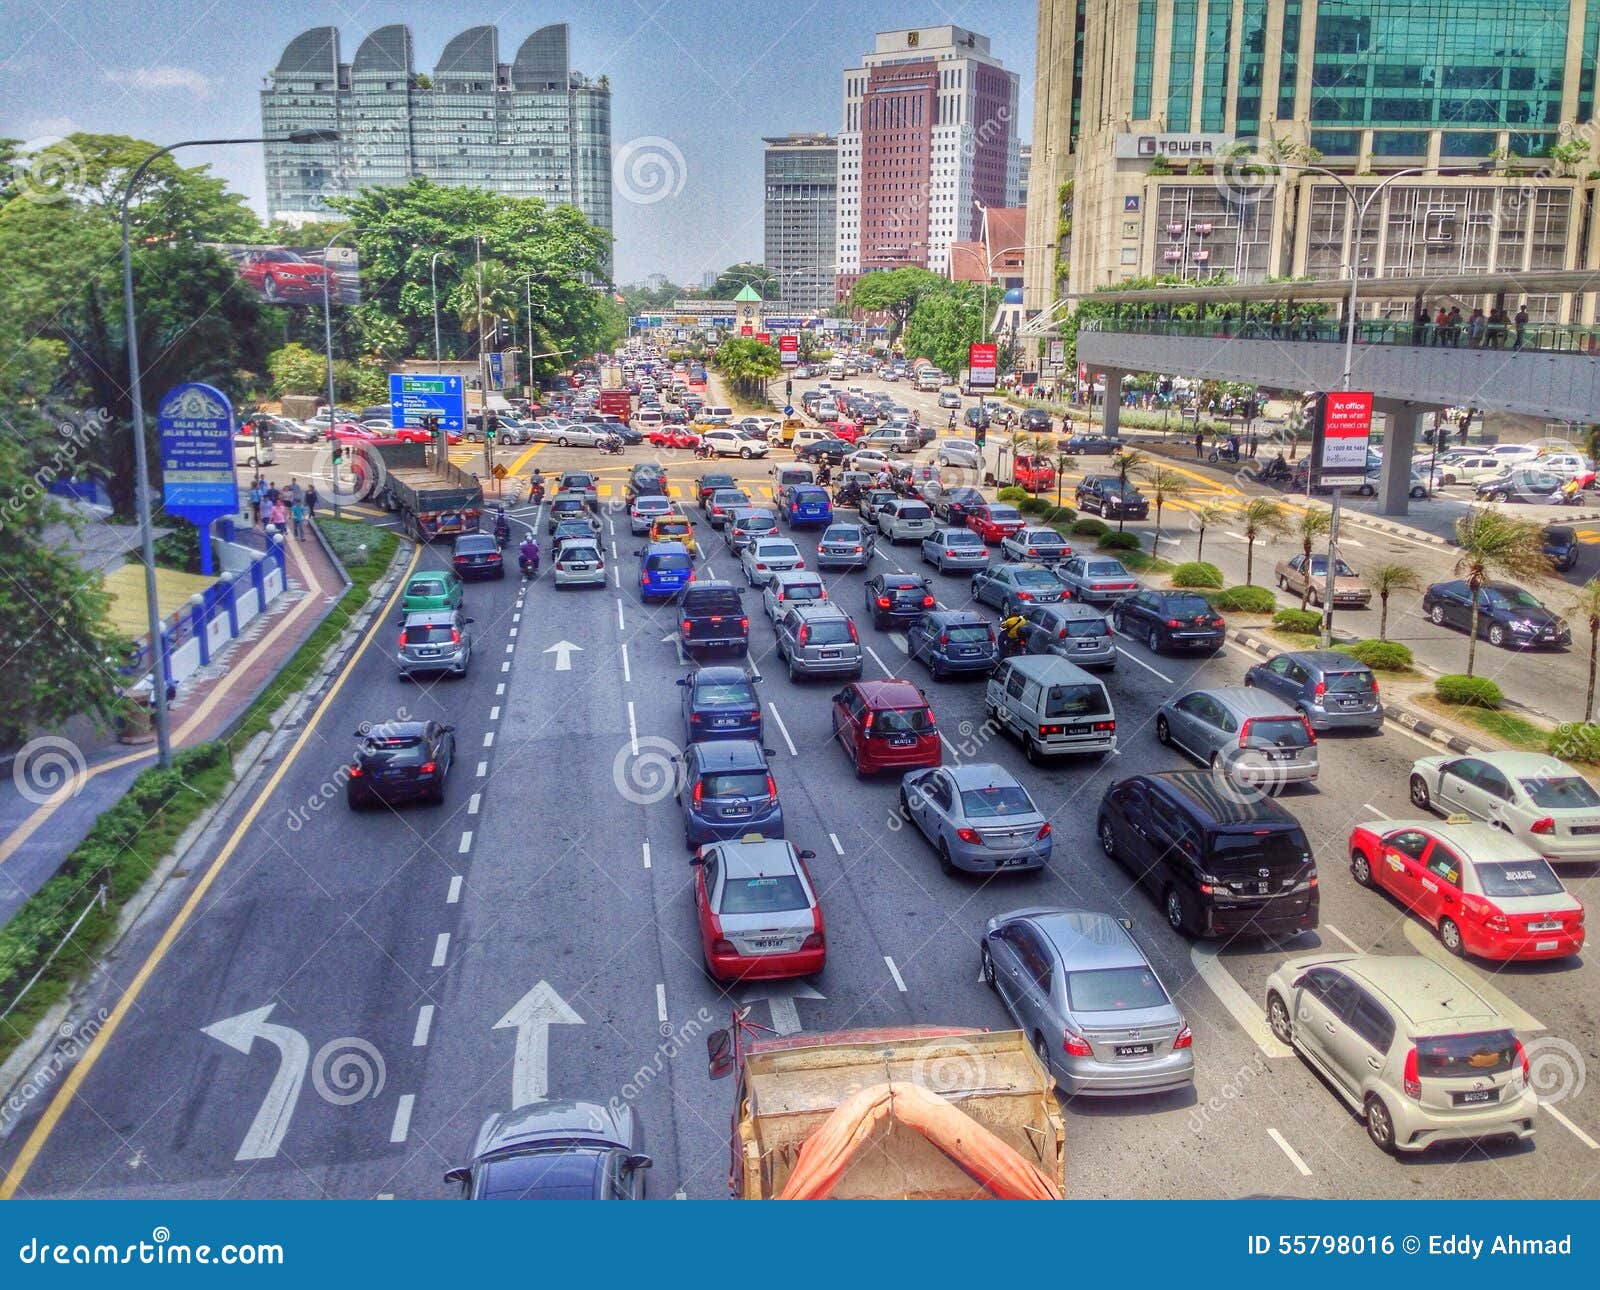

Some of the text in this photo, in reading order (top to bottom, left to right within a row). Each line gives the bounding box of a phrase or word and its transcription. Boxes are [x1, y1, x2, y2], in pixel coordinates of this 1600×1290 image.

[1159, 141, 1213, 155] TOWER
[1346, 402, 1365, 410] office
[196, 421, 217, 429] POLIS
[1340, 421, 1355, 429] need
